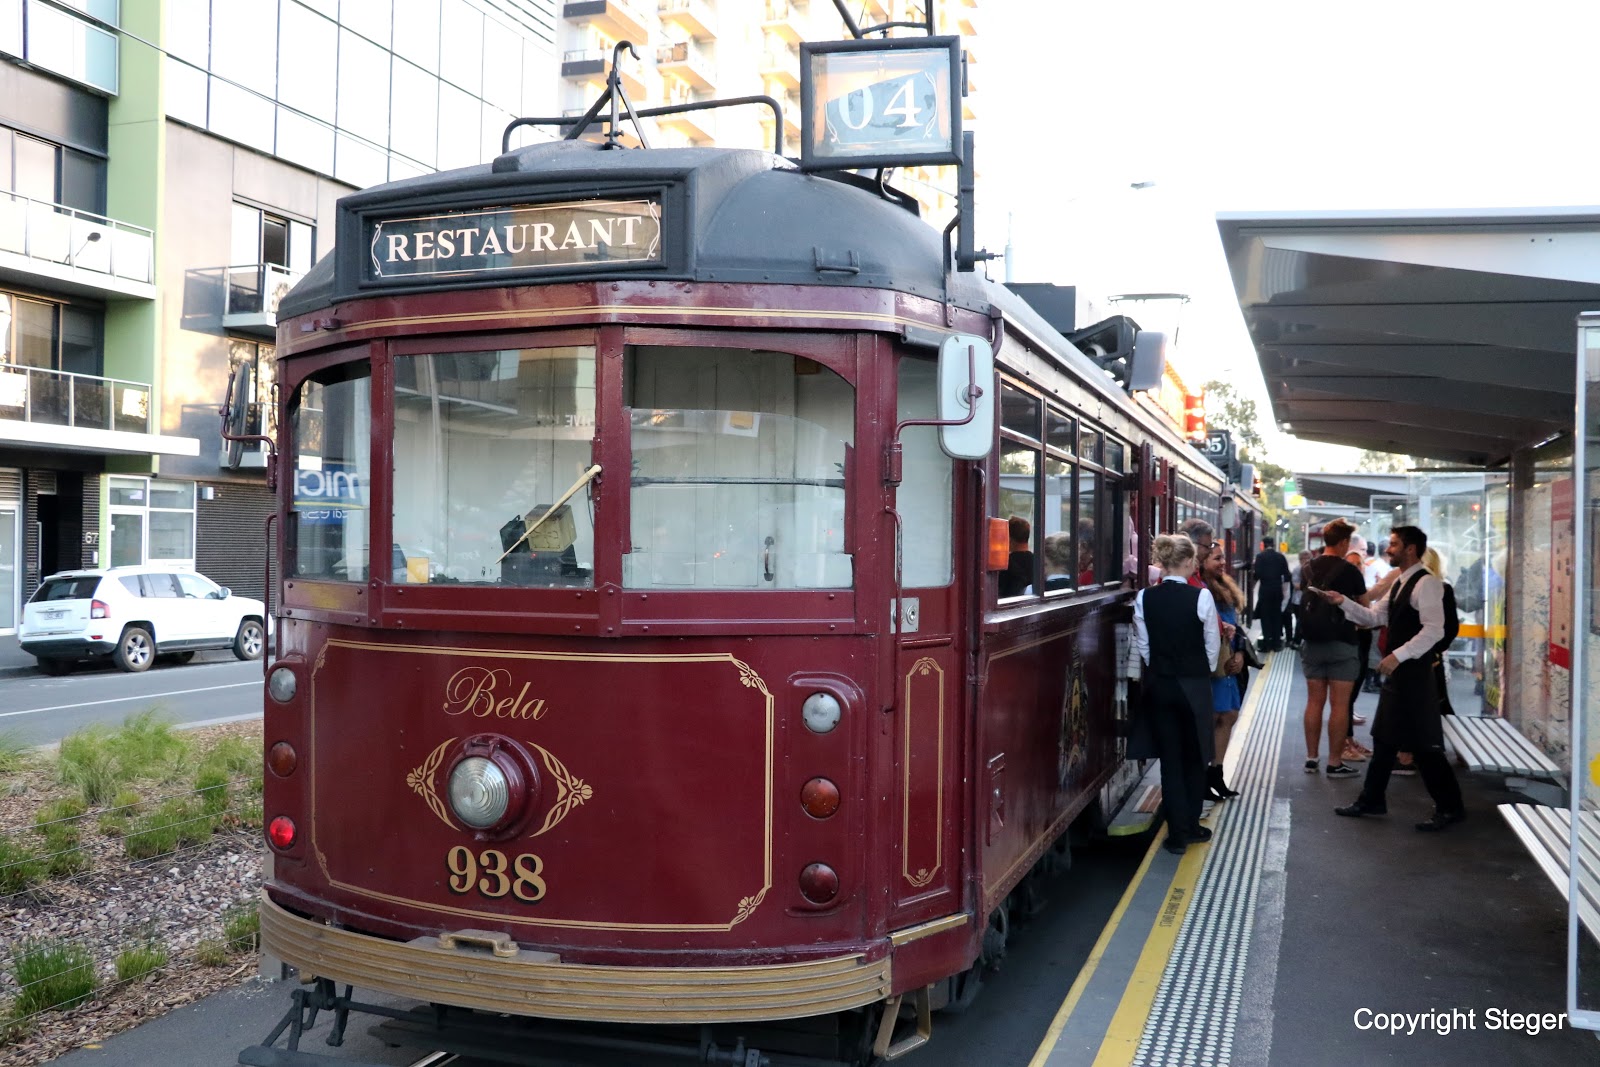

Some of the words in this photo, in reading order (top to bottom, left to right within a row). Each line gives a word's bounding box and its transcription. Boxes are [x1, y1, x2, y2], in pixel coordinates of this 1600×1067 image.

[838, 78, 924, 130] 04
[386, 216, 642, 262] RESTAURANT
[85, 532, 99, 544] 67
[443, 666, 548, 721] Bela
[447, 845, 547, 901] 938
